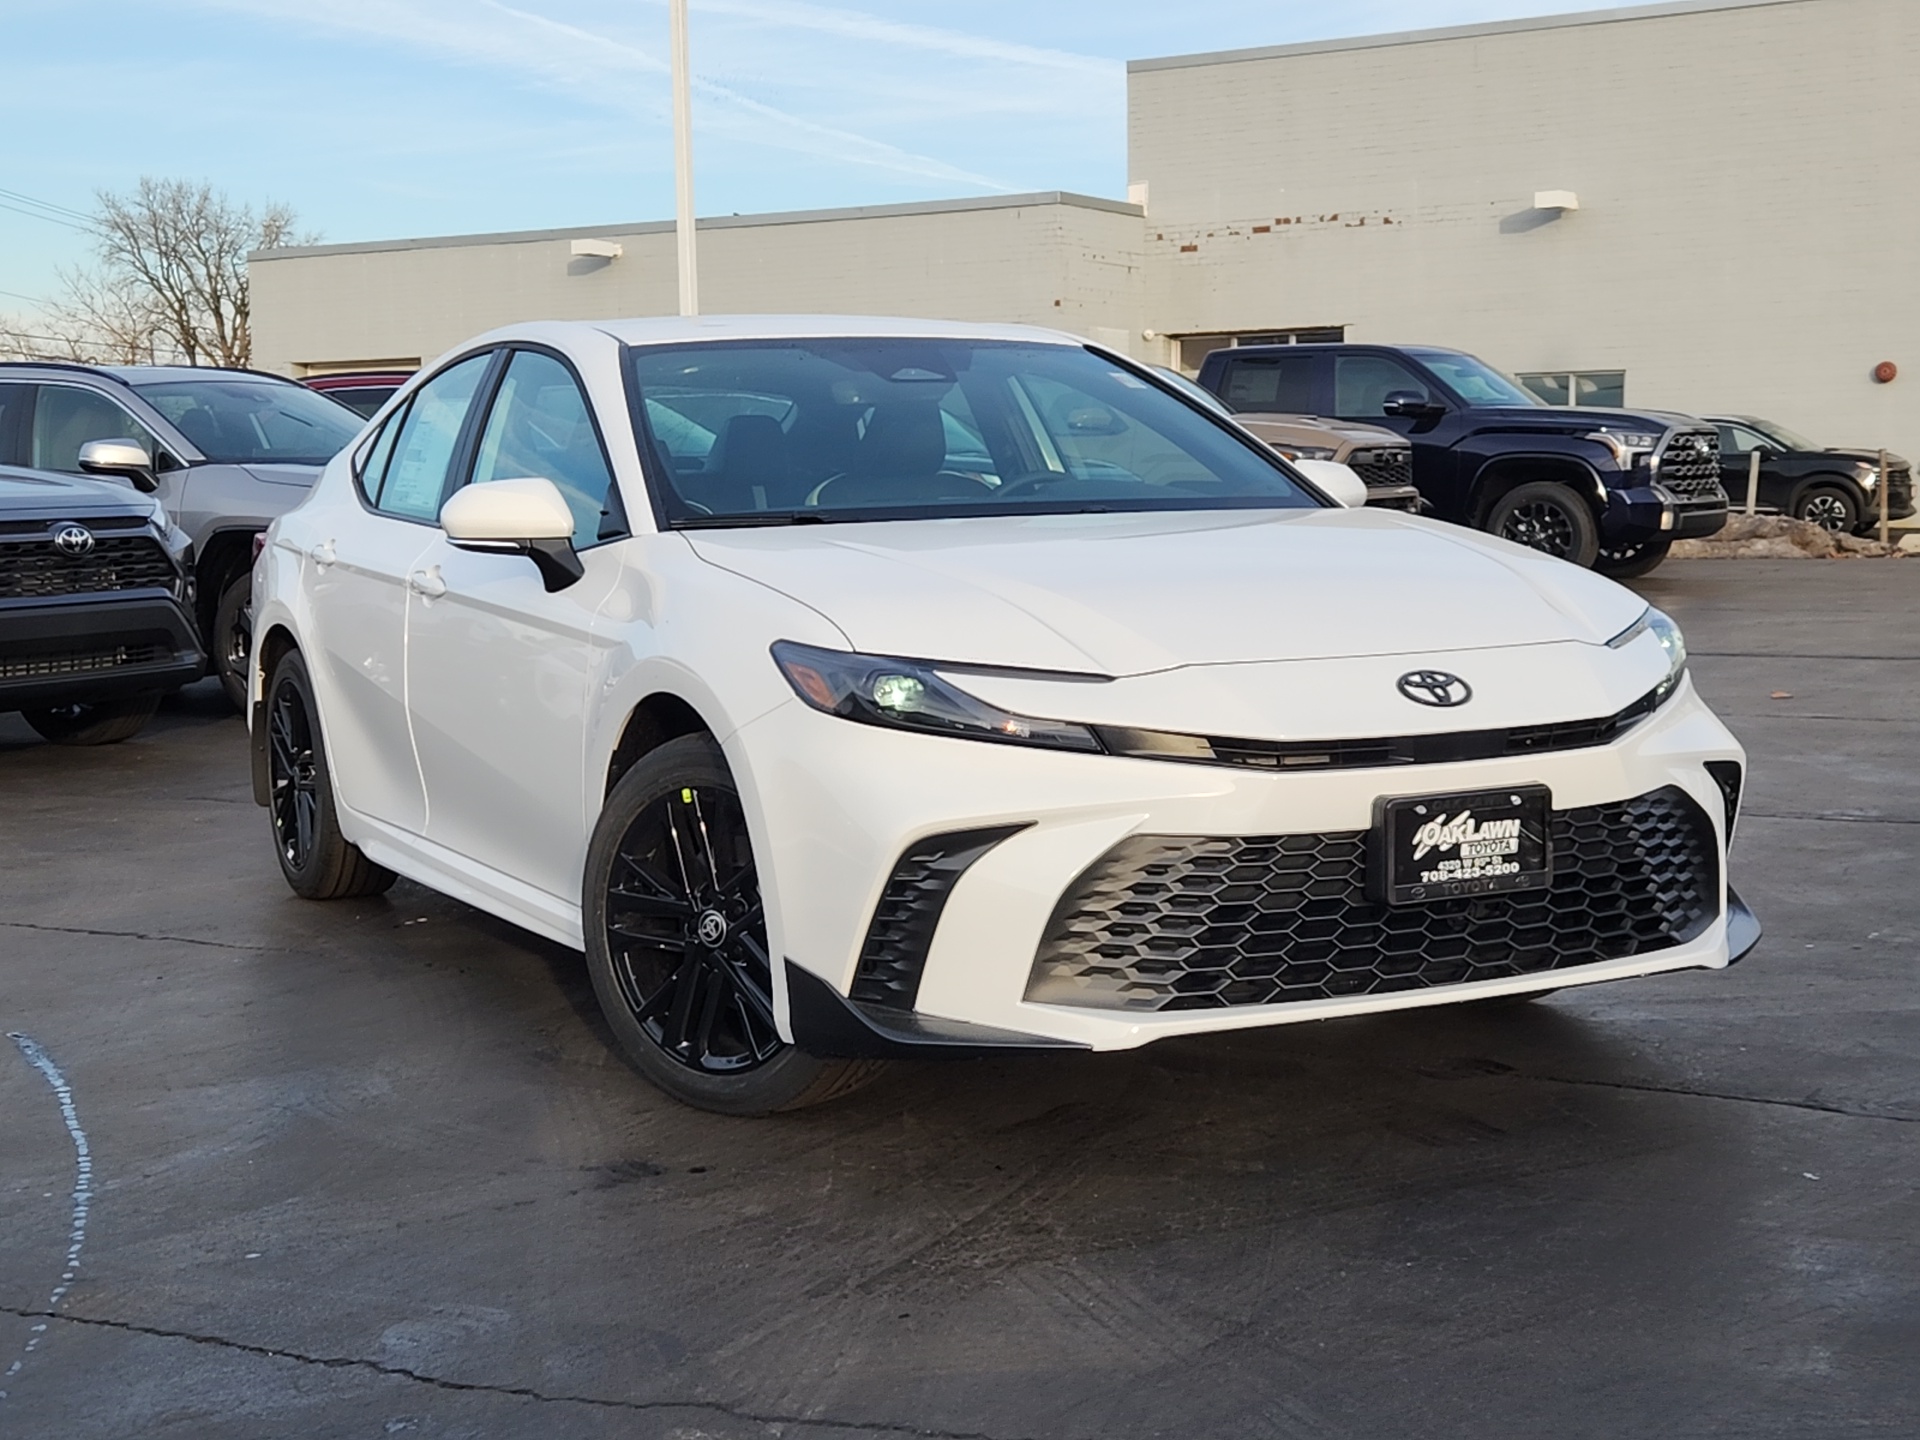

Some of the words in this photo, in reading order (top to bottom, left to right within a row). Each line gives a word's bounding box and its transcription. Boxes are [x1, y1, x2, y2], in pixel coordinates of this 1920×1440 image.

[1467, 842, 1512, 856] TOYOTA
[1420, 861, 1520, 883] 708-423-5200
[1442, 878, 1499, 895] TOYOTA
